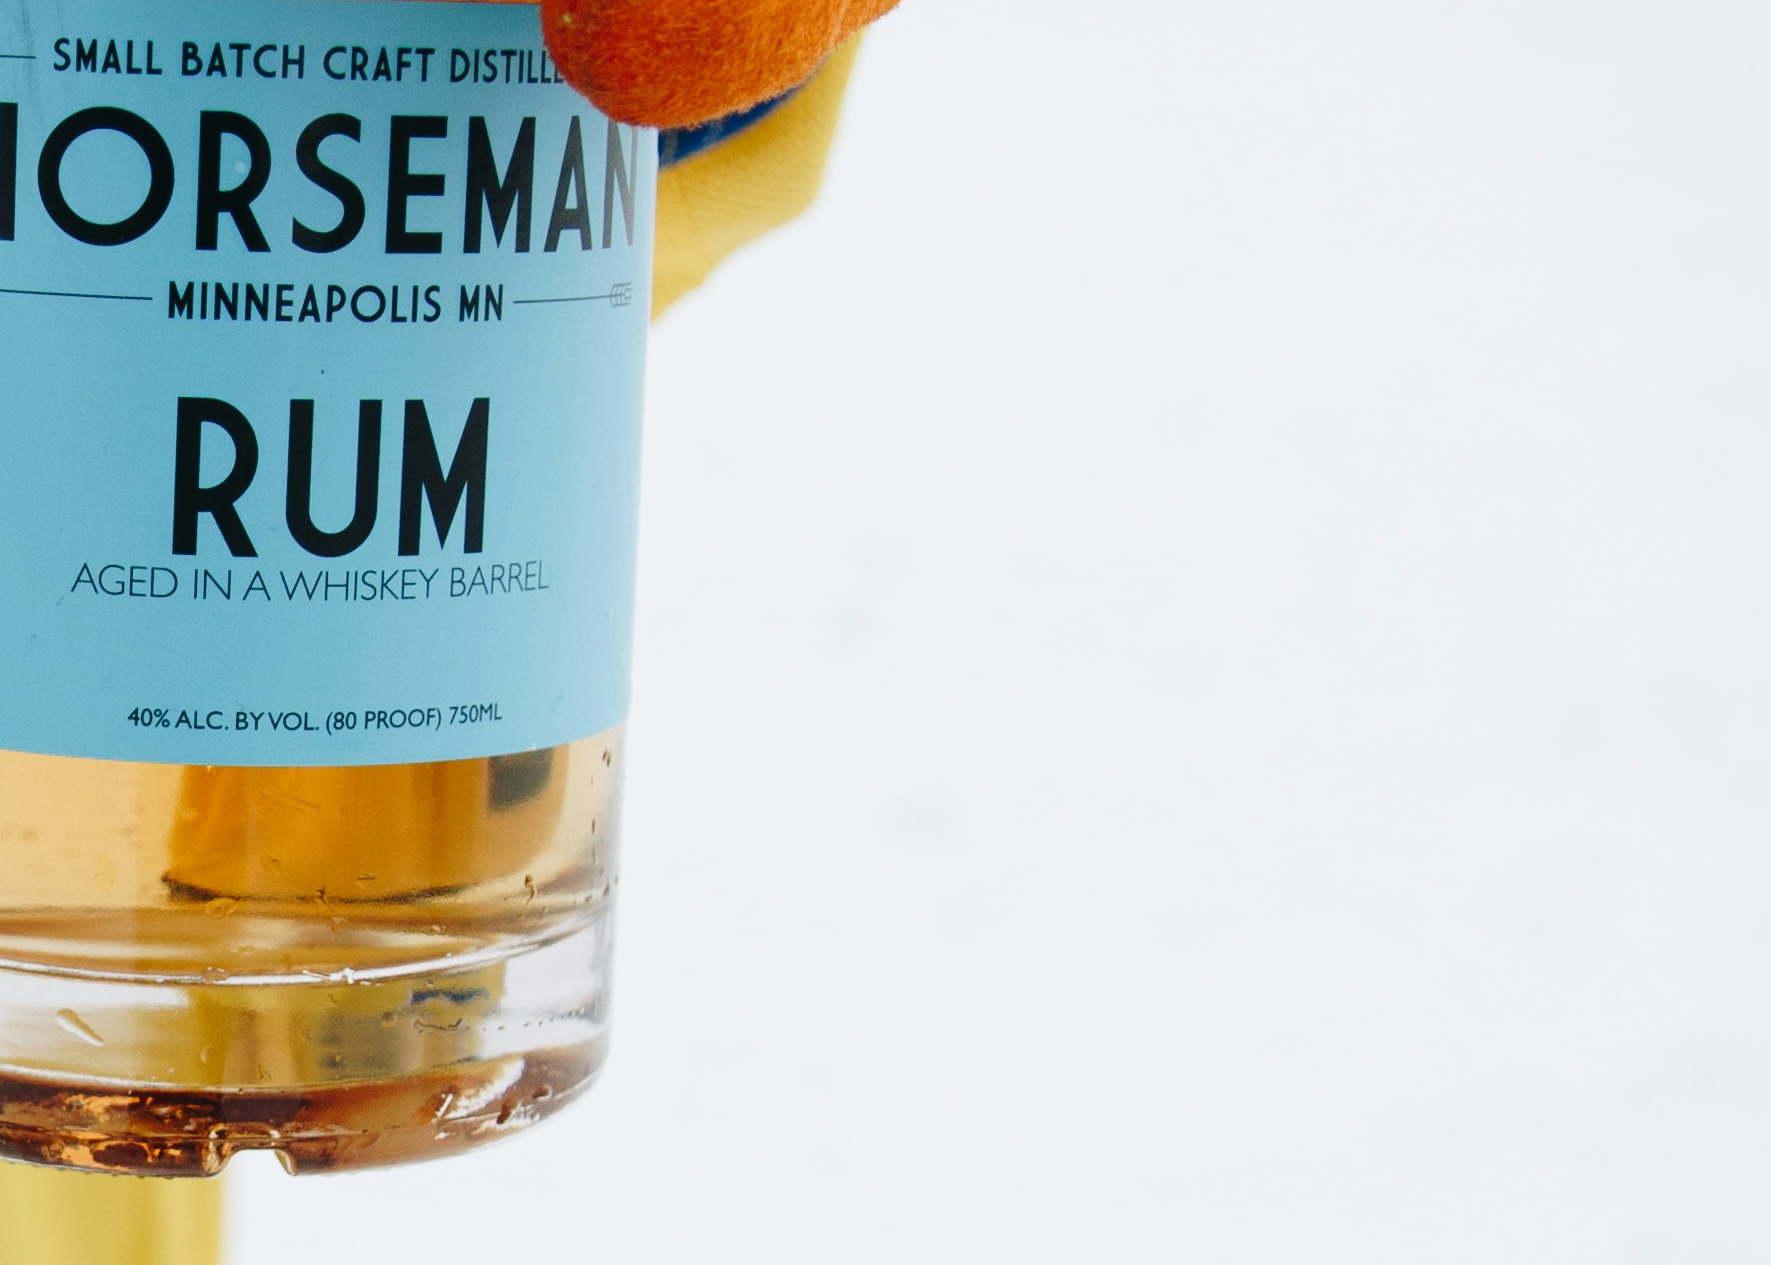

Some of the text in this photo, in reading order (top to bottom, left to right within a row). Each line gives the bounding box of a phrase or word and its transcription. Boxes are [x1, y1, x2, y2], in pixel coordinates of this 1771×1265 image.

[53, 37, 163, 76] SMALL
[181, 41, 305, 80] BATCH
[322, 45, 436, 83] CRAFT
[167, 280, 504, 323] MINNEAPOLIS MN
[171, 396, 490, 558] RUM
[70, 560, 549, 602] AGED IN A WHISKEY BARREL
[127, 702, 503, 736] 40% ALC. BY VOL. (80 PROOF) 750ML
